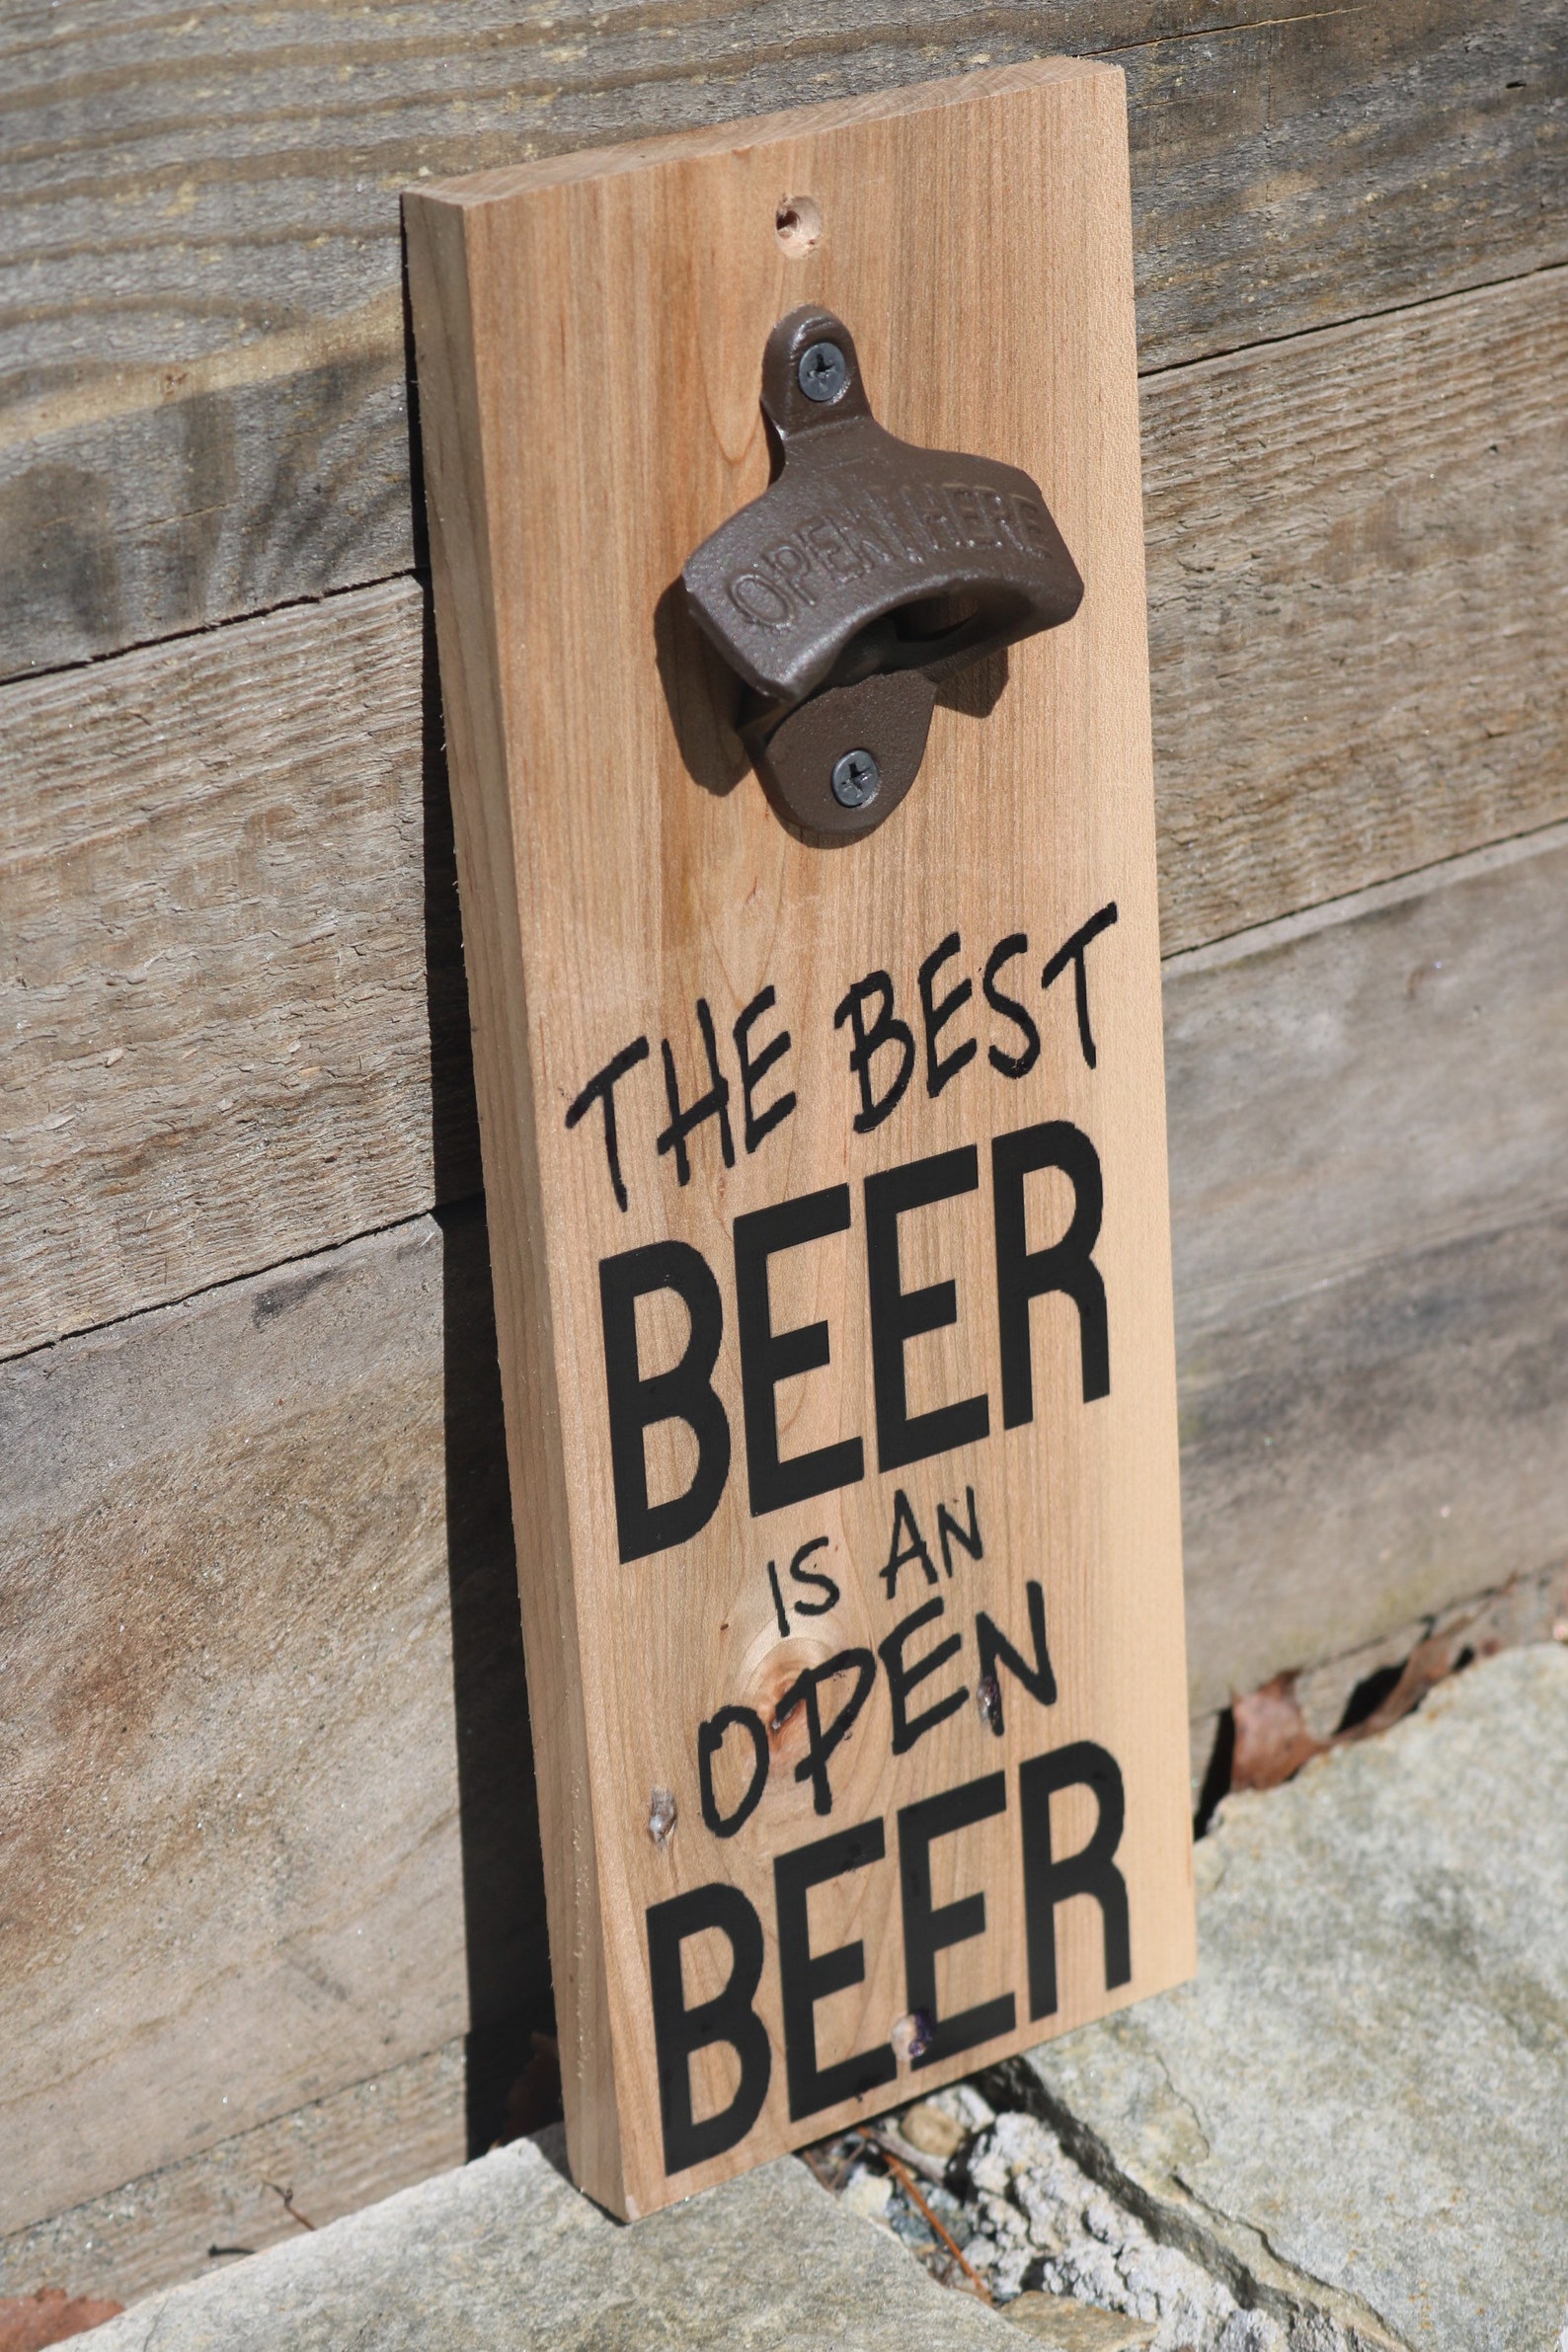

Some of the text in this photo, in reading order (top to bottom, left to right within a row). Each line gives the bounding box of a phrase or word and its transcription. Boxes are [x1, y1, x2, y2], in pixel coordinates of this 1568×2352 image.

[724, 480, 1053, 632] OPEN HERE
[566, 901, 1118, 1213] THE BEST
[598, 1120, 1111, 1565] BEER
[767, 1486, 983, 1638] IS AN
[697, 1580, 1057, 1839] OPEN
[646, 1740, 1133, 2176] BEER
